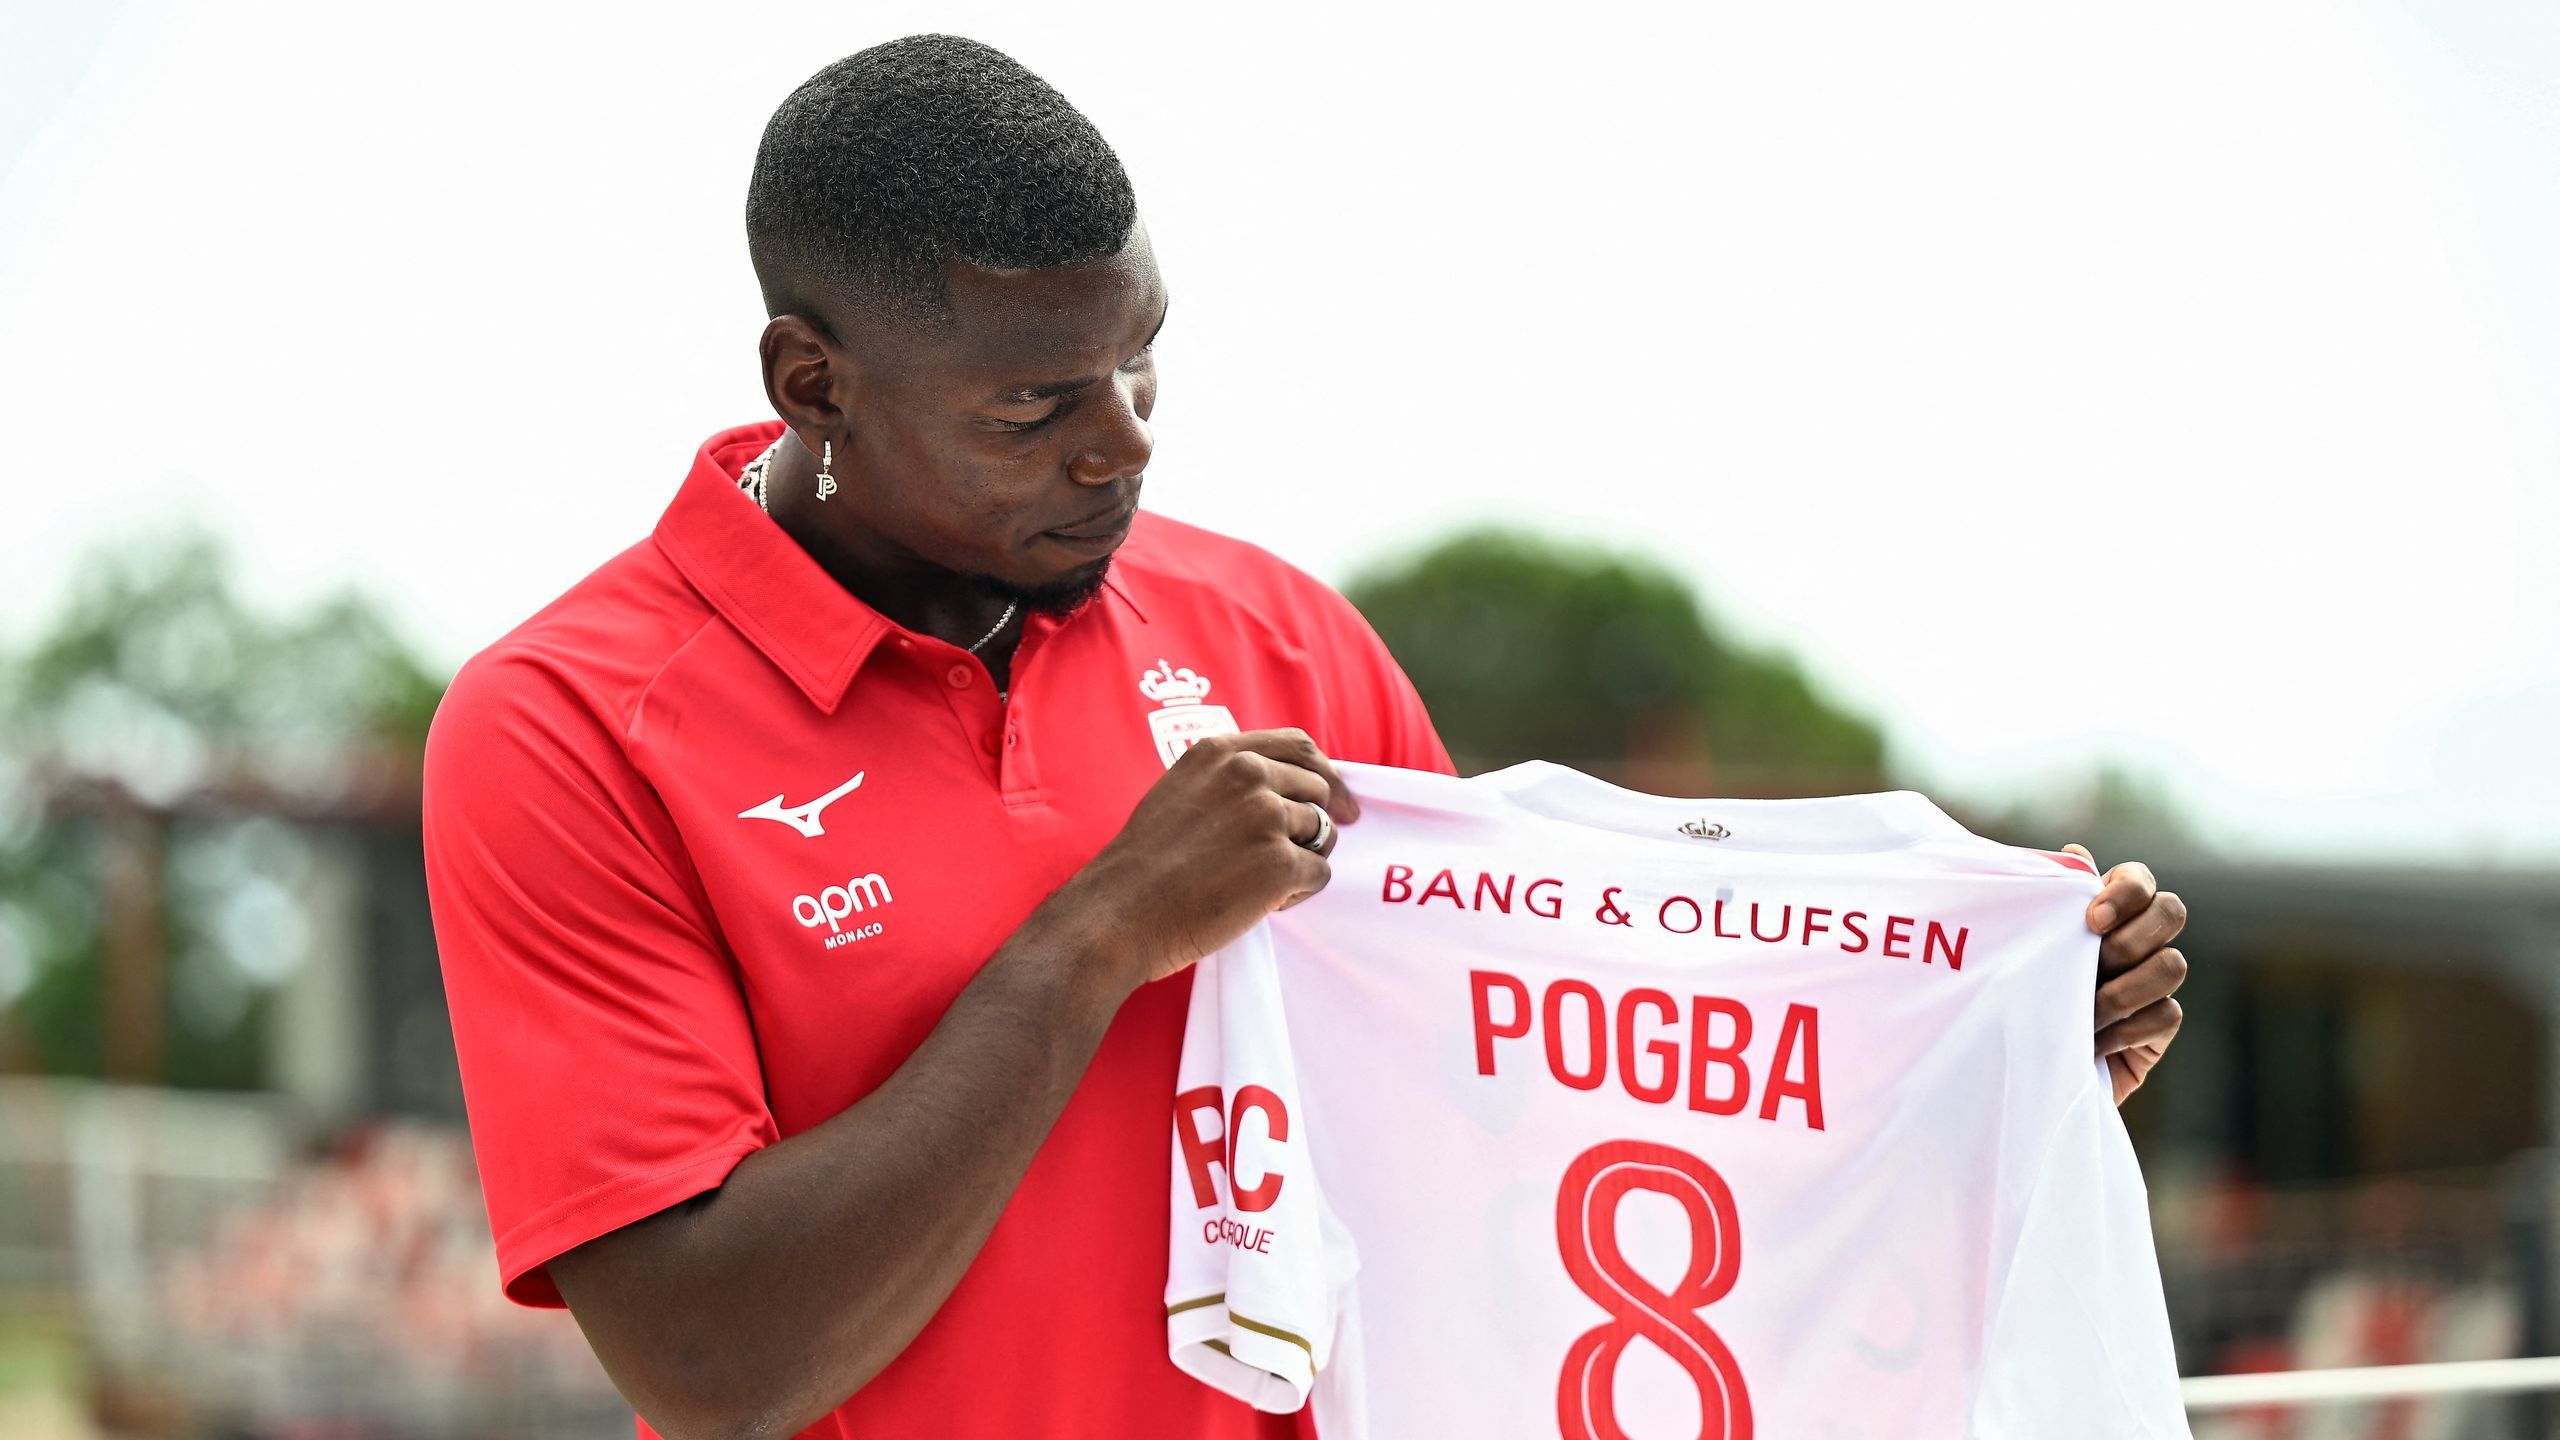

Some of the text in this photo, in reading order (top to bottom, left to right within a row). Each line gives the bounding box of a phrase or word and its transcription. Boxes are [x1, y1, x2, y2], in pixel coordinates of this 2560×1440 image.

[792, 873, 893, 934] apm
[824, 922, 883, 950] MONACO
[1382, 864, 1970, 972] BANG & OLUFSEN
[1469, 969, 1825, 1132] POGBA
[1554, 1138, 1755, 1440] 8
